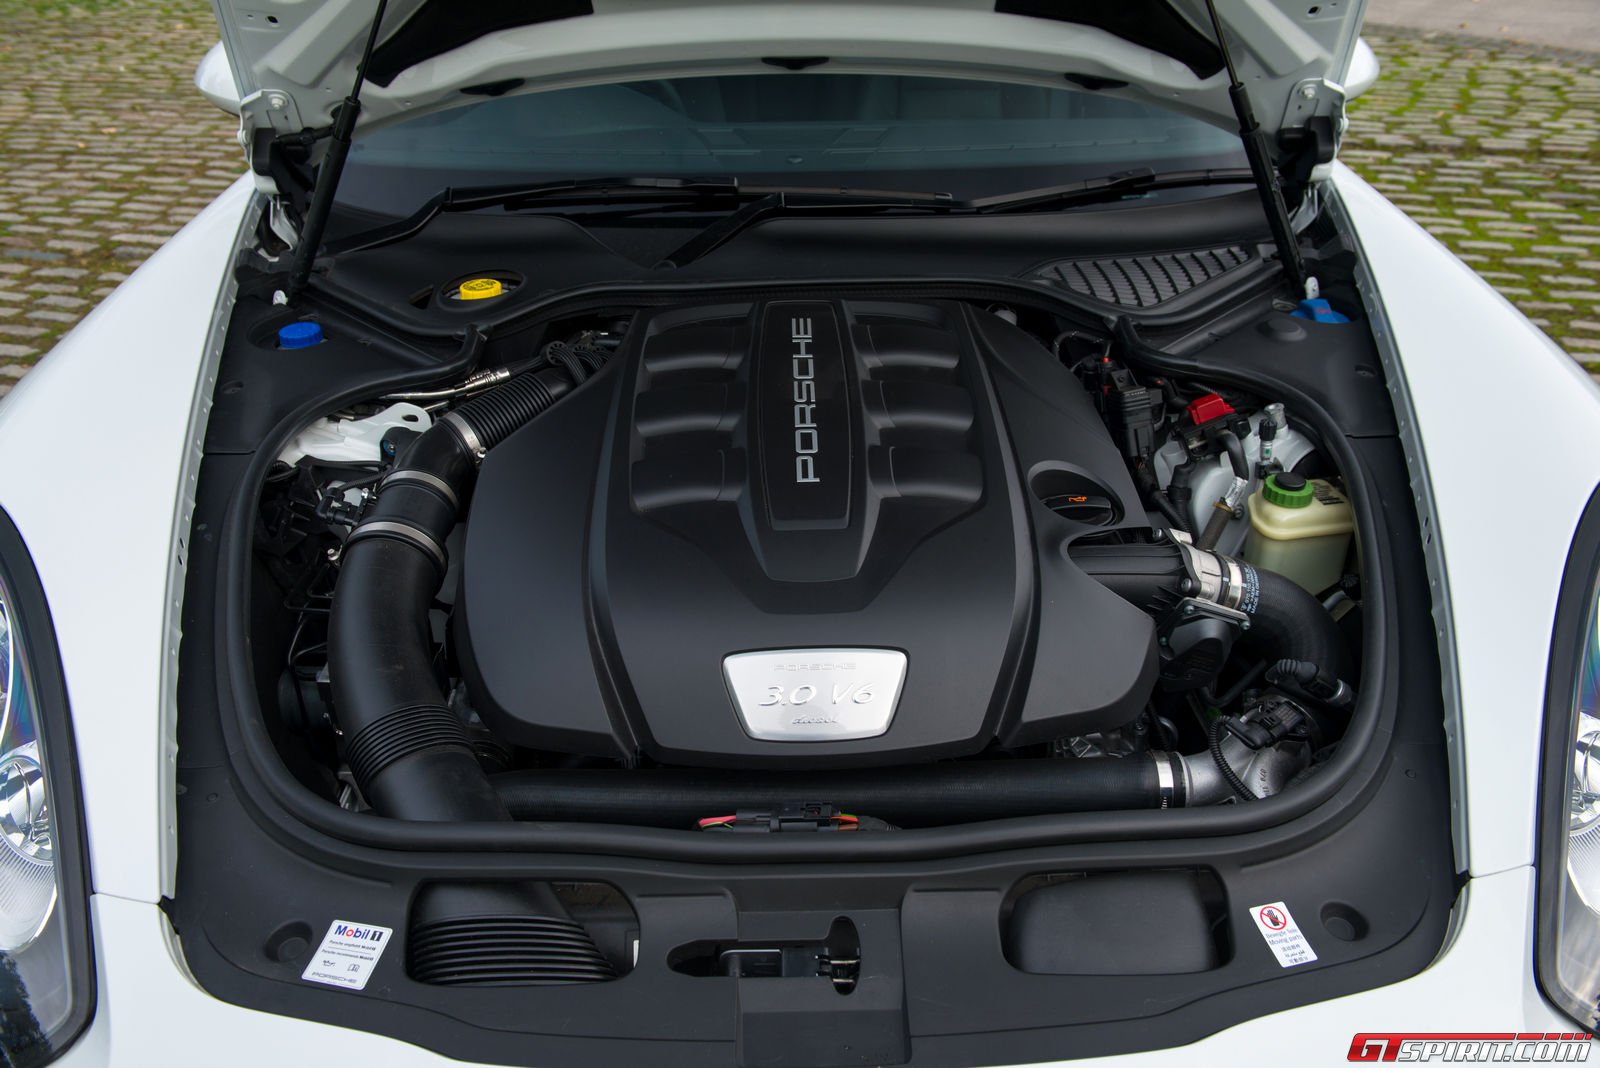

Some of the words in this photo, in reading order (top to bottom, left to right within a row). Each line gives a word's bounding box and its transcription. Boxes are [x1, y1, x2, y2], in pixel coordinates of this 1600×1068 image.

[791, 317, 821, 483] PORSCHE
[773, 663, 857, 672] PORSCHE
[758, 685, 817, 707] 3.0
[831, 682, 875, 705] V6
[334, 925, 370, 940] Mobil
